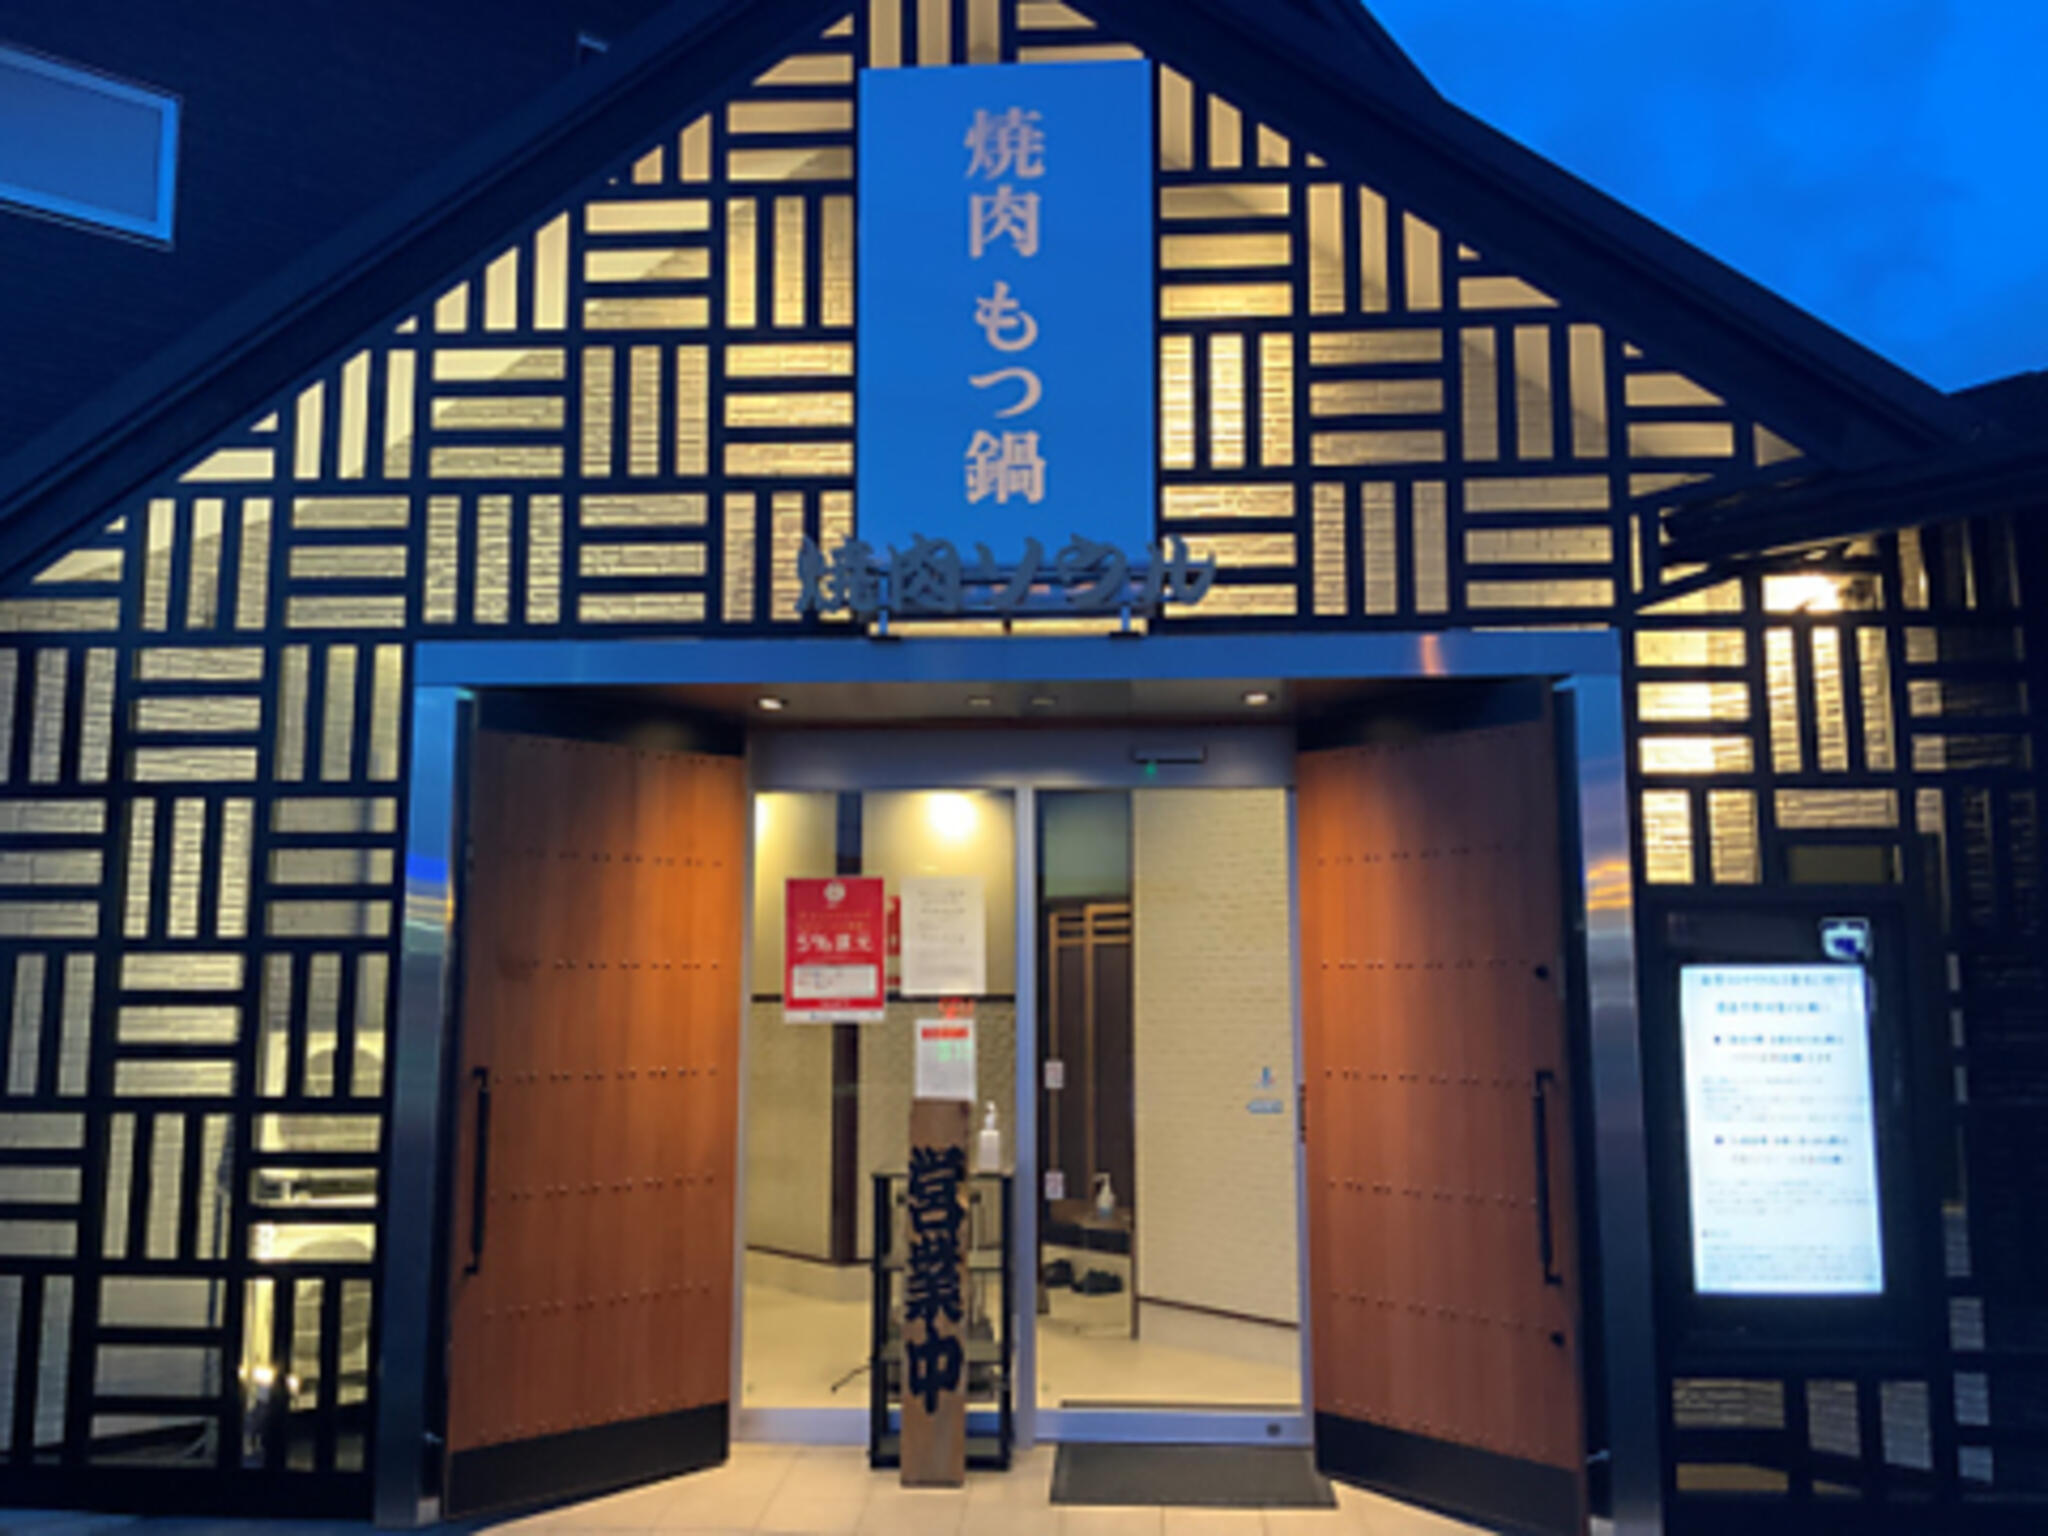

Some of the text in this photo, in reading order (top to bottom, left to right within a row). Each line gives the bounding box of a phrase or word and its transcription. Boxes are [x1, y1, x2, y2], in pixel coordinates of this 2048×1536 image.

[795, 533, 1217, 613] 焼肉ソウル
[904, 1145, 966, 1415] 営業中
